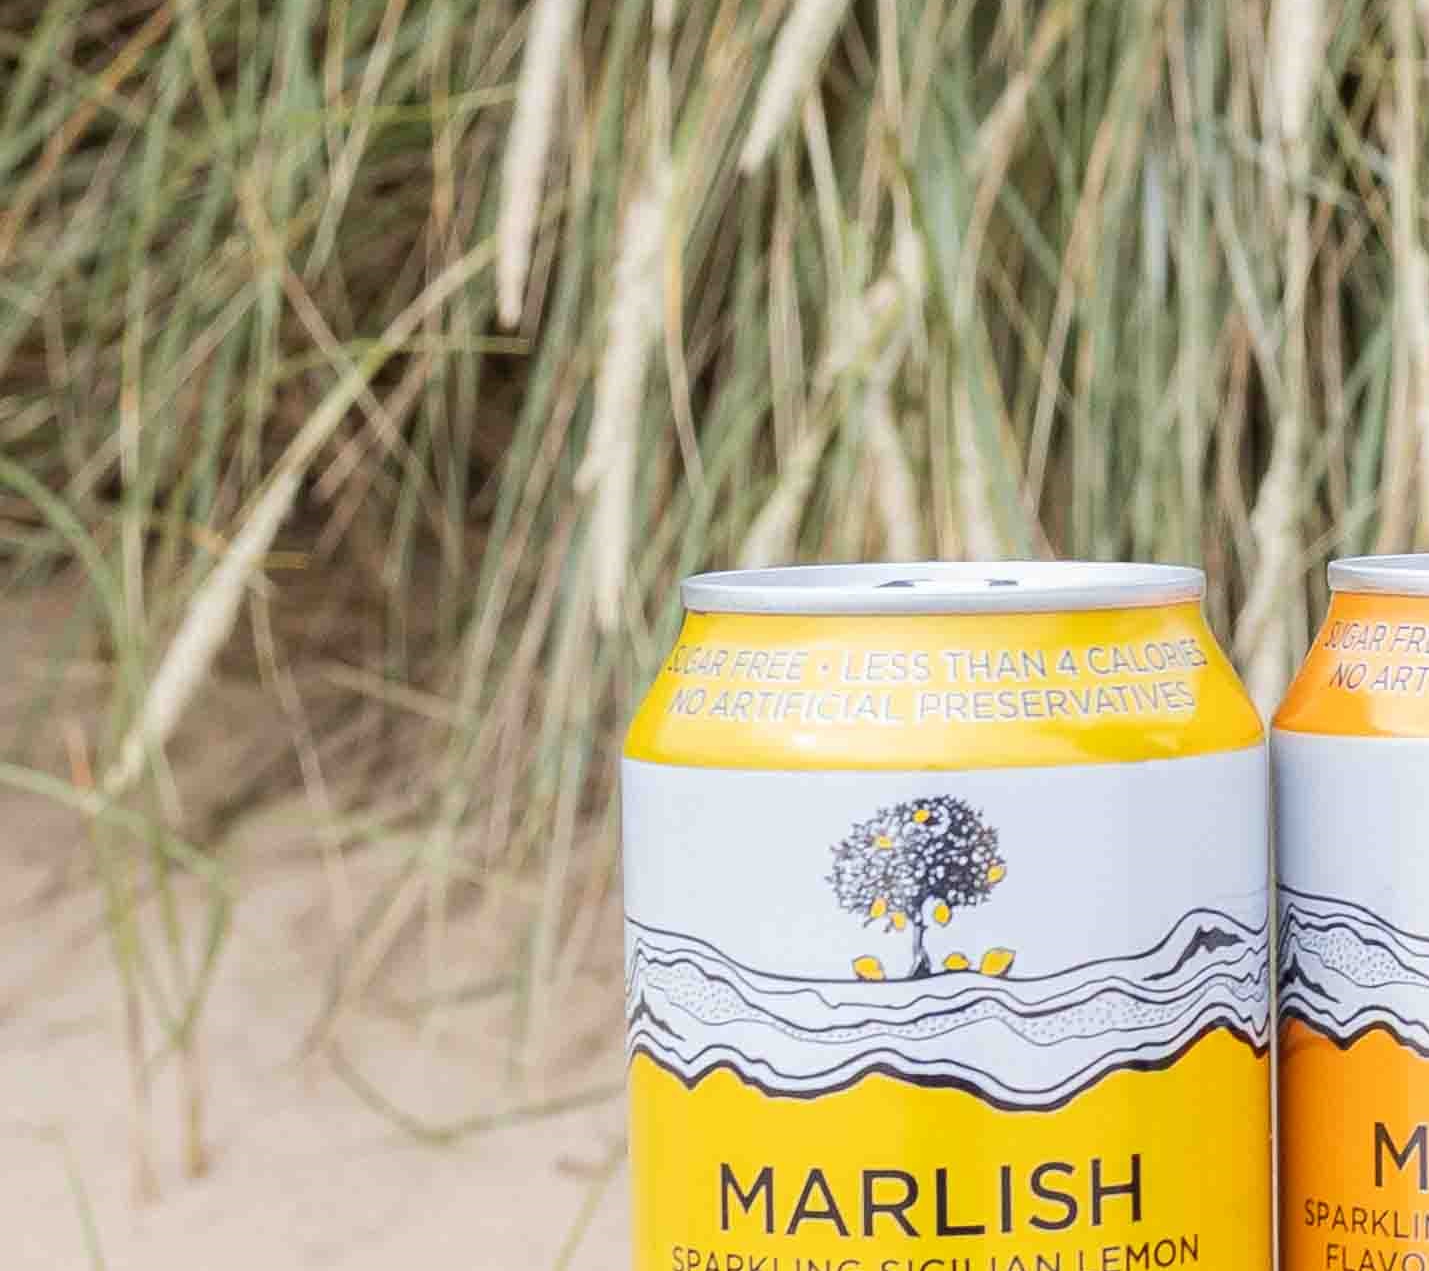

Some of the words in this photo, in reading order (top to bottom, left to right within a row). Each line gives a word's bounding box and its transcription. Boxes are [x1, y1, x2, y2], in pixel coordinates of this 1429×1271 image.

[730, 650, 808, 680] FREE
[844, 652, 931, 680] LESS
[947, 650, 1047, 679] THAN
[1058, 649, 1078, 676] 4
[1087, 639, 1207, 675] CALORIES
[1329, 662, 1367, 690] NO
[667, 689, 705, 716] NO
[710, 691, 904, 720] ARTIFICIAL
[920, 681, 1196, 720] PRESERVATIVES
[720, 1153, 1142, 1238] MARLISH
